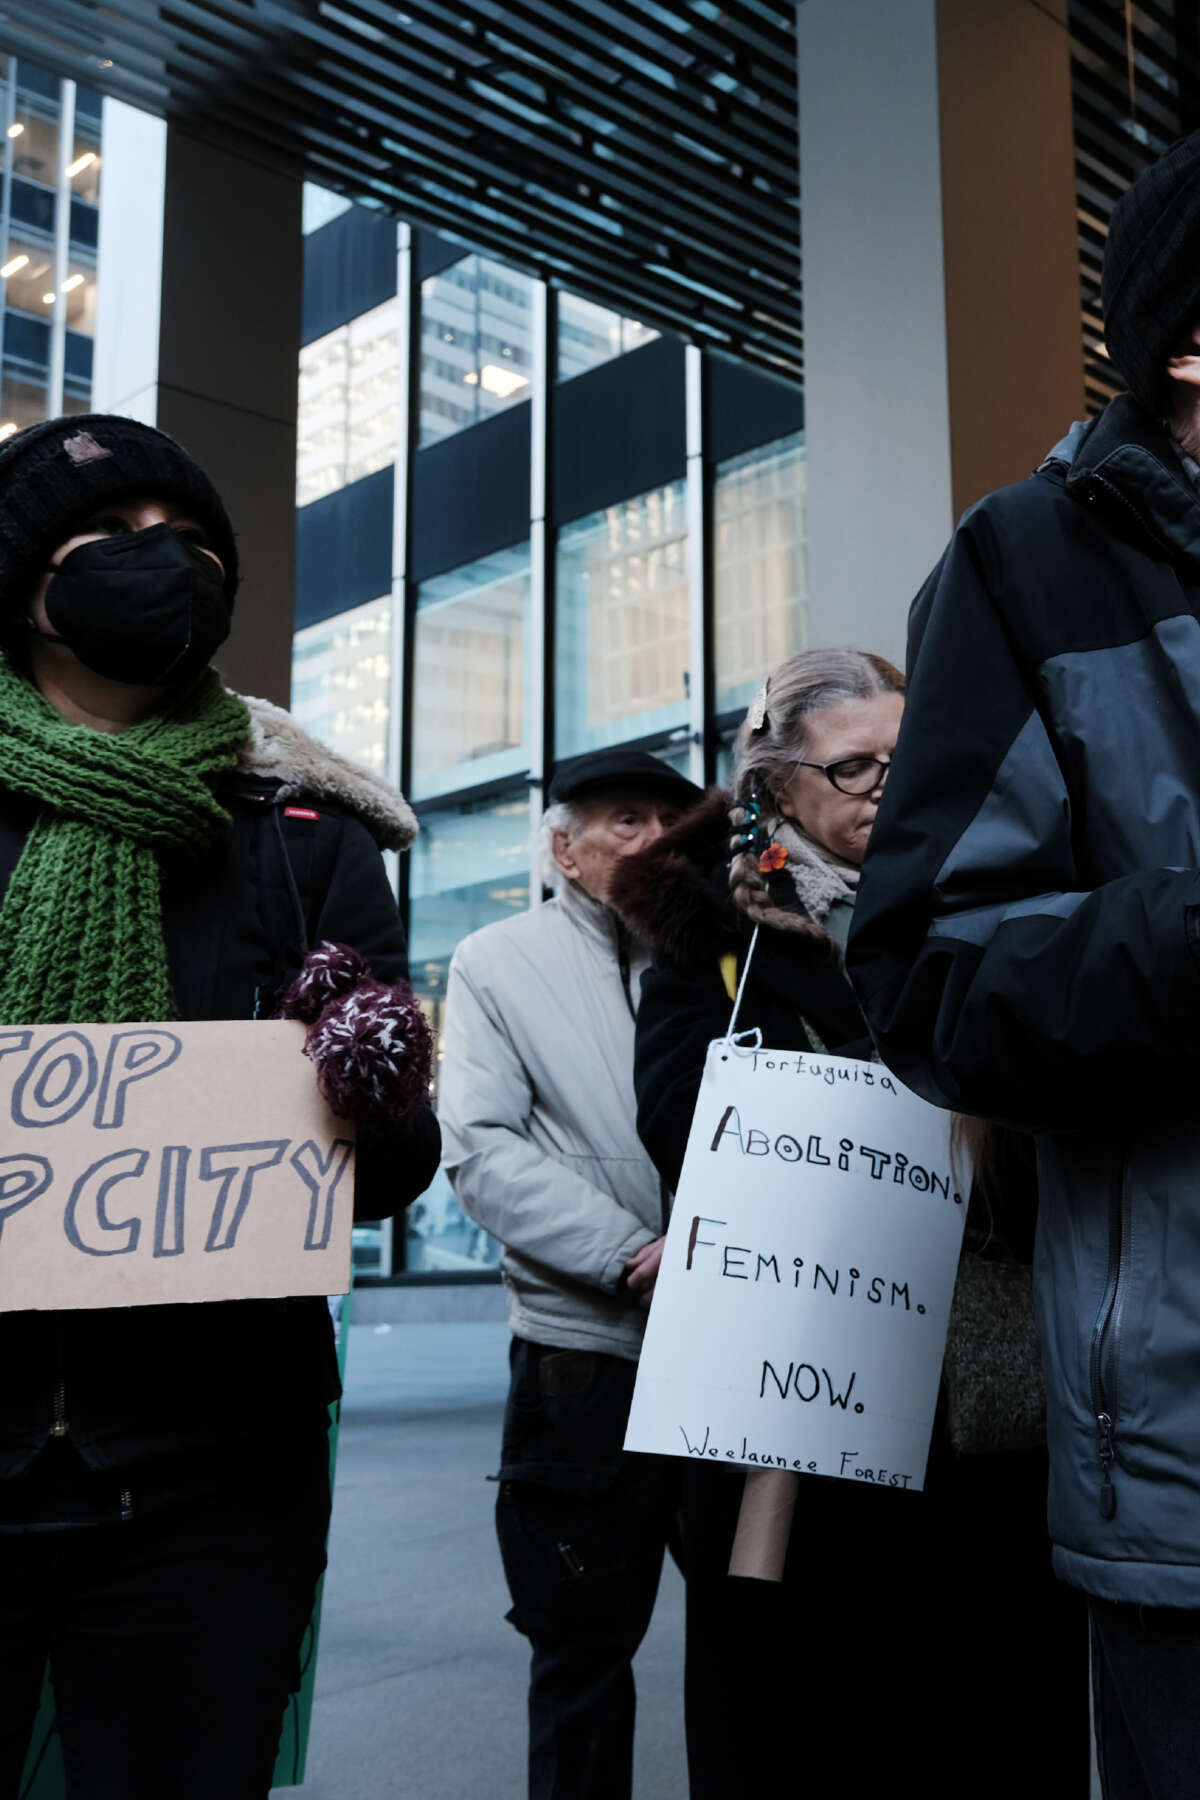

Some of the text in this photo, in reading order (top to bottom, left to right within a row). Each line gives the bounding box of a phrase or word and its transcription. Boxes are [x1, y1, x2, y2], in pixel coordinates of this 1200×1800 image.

[64, 1138, 355, 1258] CITY
[760, 1360, 864, 1414] NOW.
[679, 1425, 817, 1472] Weelaunee
